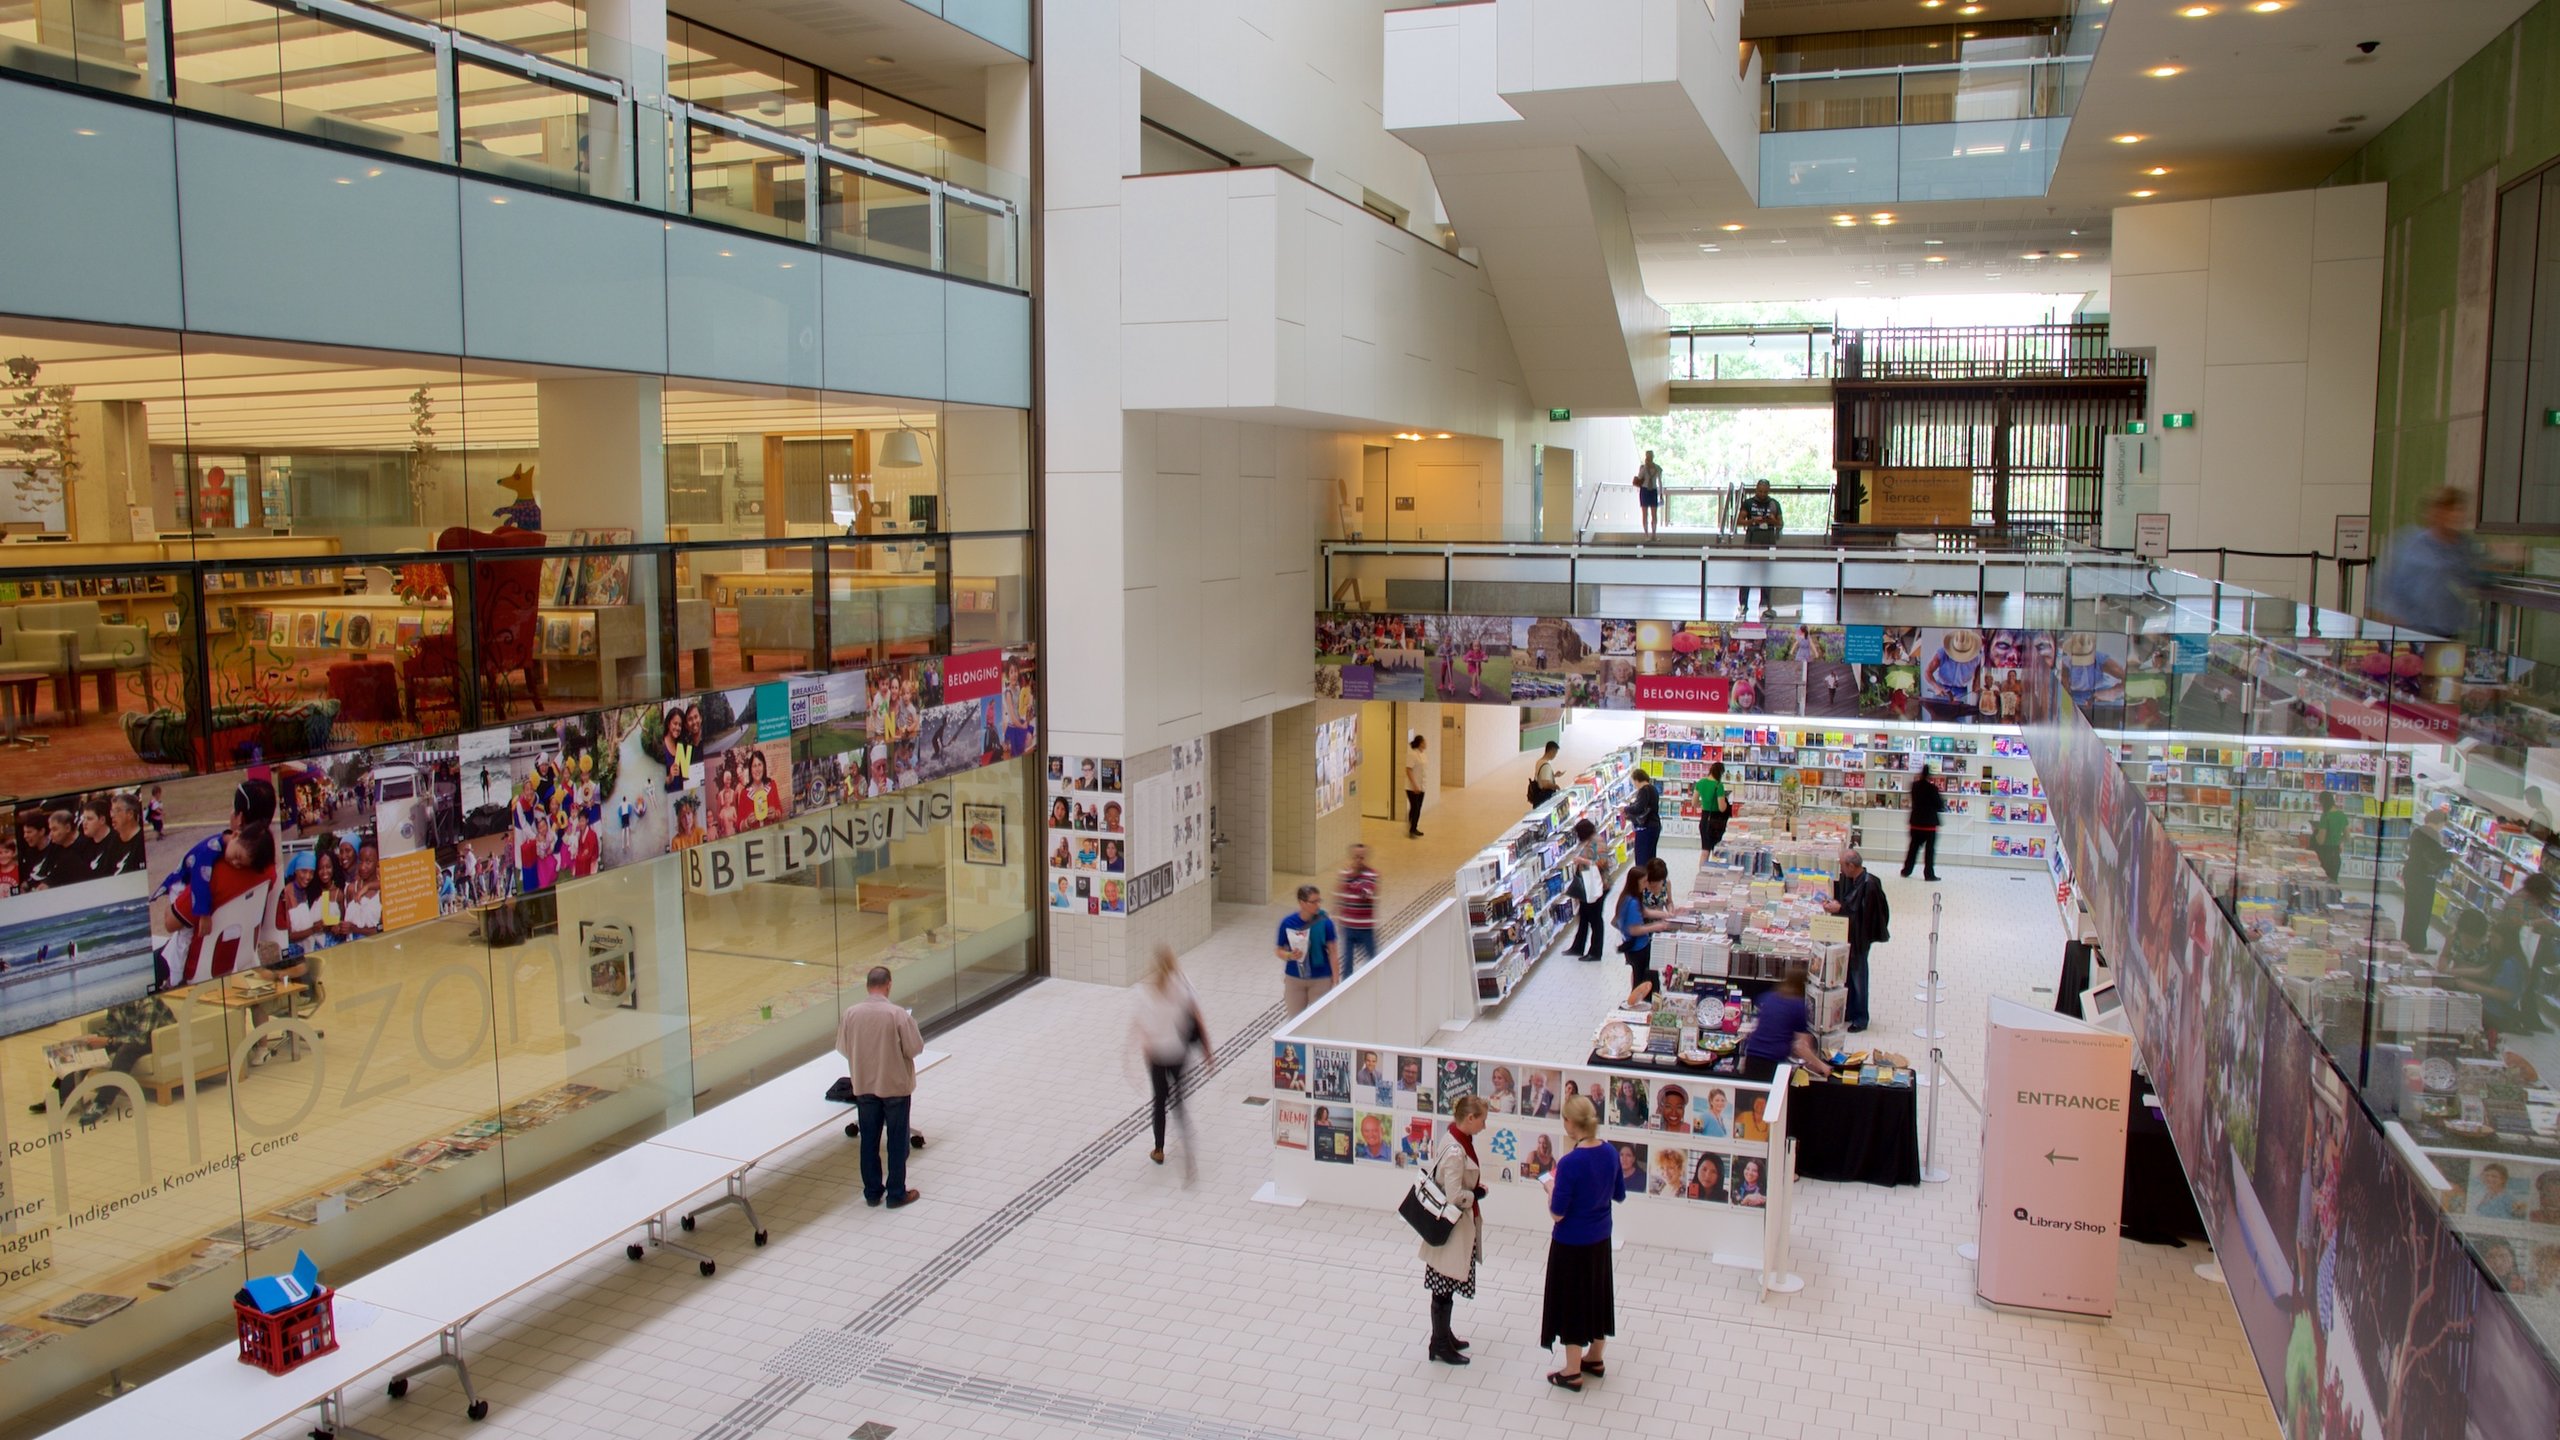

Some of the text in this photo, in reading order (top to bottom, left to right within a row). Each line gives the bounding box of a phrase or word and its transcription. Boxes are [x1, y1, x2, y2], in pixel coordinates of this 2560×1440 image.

[2115, 441, 2126, 494] Auditorium
[1882, 491, 1931, 503] Terrace
[948, 666, 999, 687] BELONGING
[792, 684, 825, 697] BREAKFAST
[1643, 688, 1720, 701] BELONGING
[792, 700, 807, 711] Cold
[812, 695, 827, 705] FUEL
[792, 713, 807, 727] BEER
[2072, 1039, 2098, 1047] Writers
[2098, 1041, 2125, 1049] Festival
[1314, 1049, 1349, 1061] ALL FALL
[1315, 1059, 1349, 1073] DOWN
[2017, 1091, 2121, 1112] ENTRANCE
[1279, 1109, 1308, 1129] ENEMY
[9, 1128, 72, 1158] Rooms
[69, 1186, 158, 1229] Indigenous
[163, 1152, 246, 1192] Knowledge
[250, 1131, 299, 1157] Centre
[2029, 1216, 2072, 1231] Library
[2074, 1220, 2106, 1234] Shop
